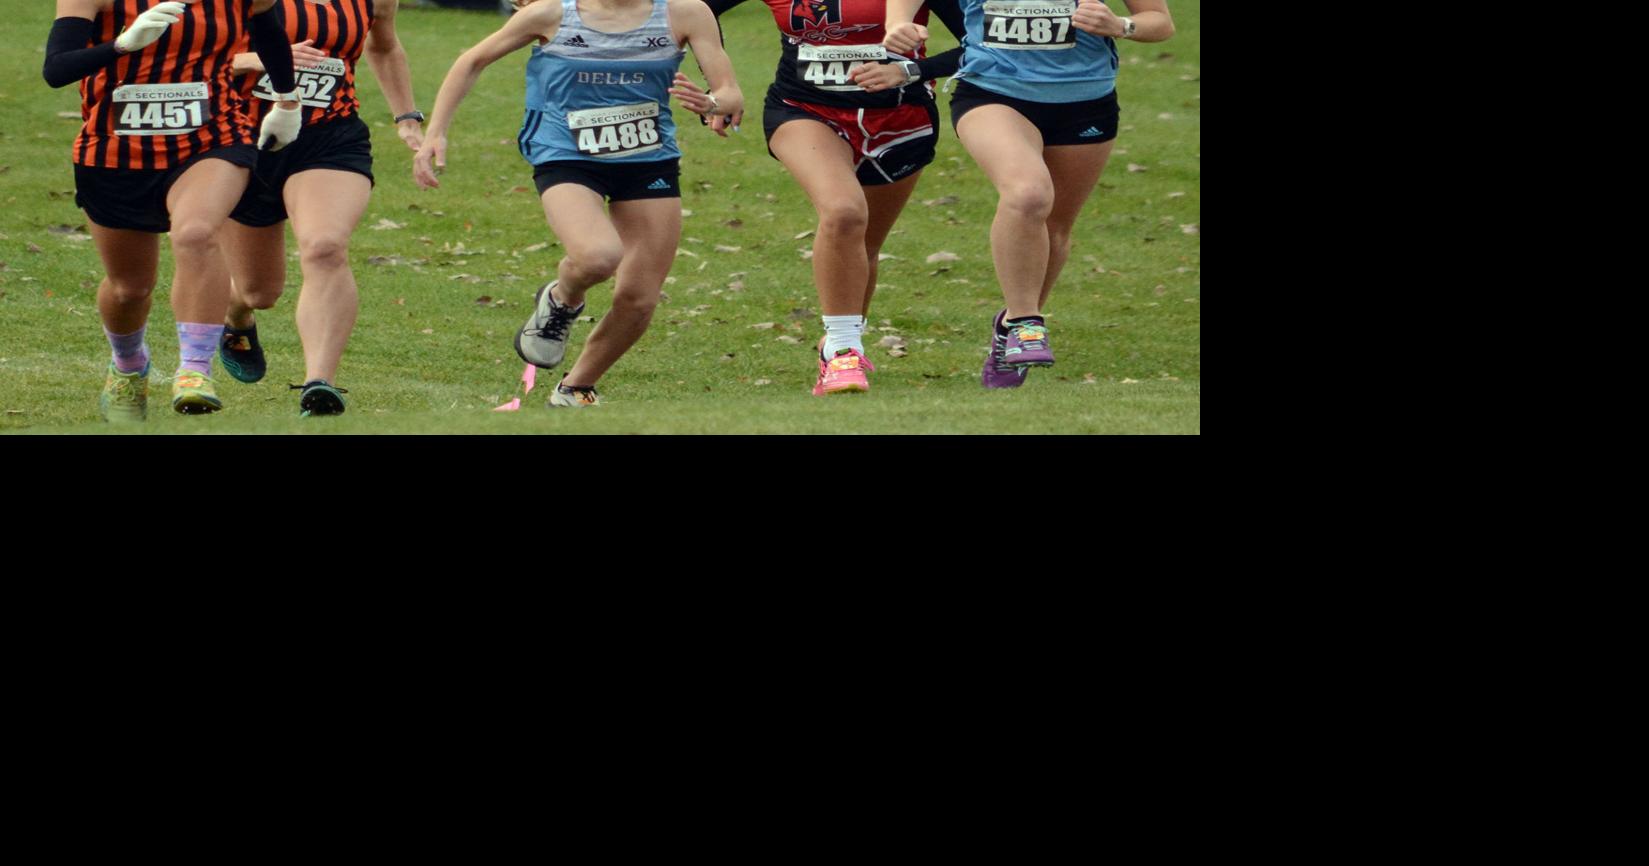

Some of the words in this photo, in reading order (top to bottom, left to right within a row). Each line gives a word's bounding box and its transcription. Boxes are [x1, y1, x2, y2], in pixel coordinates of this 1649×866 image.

[1003, 7, 1071, 16] SECTIONALS
[988, 16, 1070, 43] 4487
[816, 51, 883, 60] SECTIONALS
[577, 71, 645, 85] DELLS
[257, 71, 336, 101] 452
[135, 90, 204, 99] SECTIONALS
[120, 100, 202, 128] 4451
[590, 109, 655, 124] SECTIONALS
[578, 118, 659, 153] 4488
